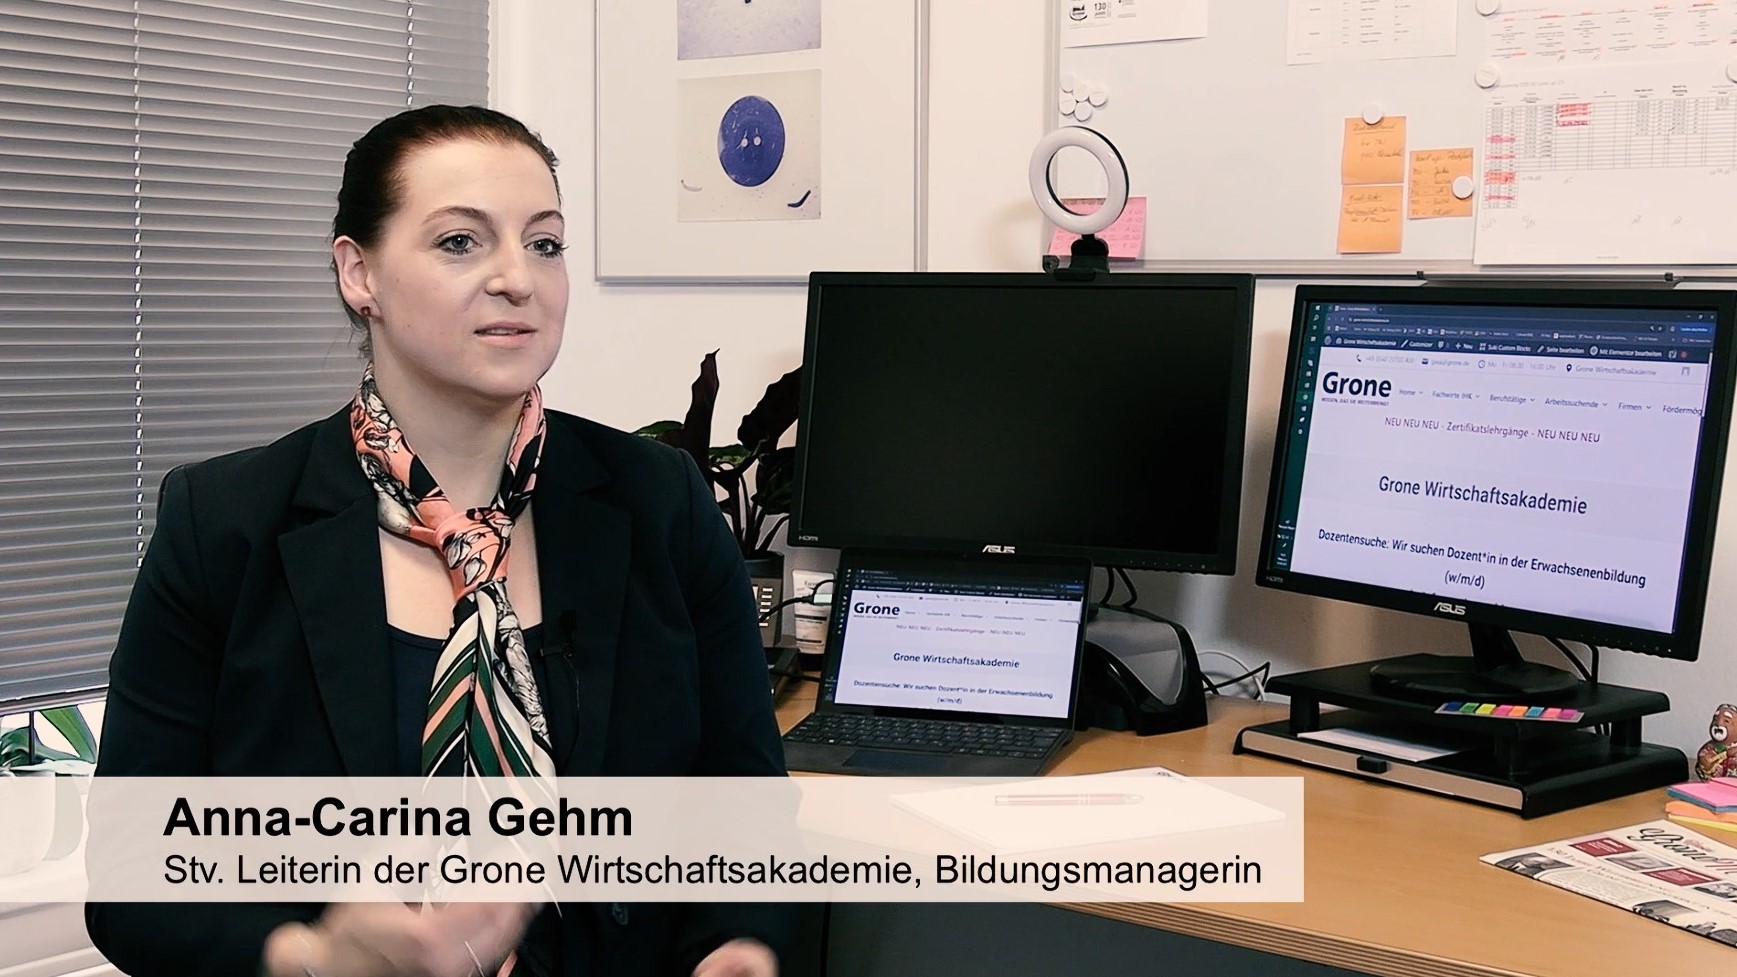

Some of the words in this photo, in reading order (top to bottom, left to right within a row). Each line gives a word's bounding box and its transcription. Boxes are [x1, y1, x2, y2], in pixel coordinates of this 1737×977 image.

[1322, 371, 1392, 397] Grone
[1618, 402, 1643, 411] Firmen
[1384, 417, 1401, 427] NEU
[1403, 418, 1420, 428] NEU
[1422, 420, 1440, 430] NEU
[1446, 421, 1529, 439] Zertifikatslehrgänge
[1537, 429, 1556, 439] NEU
[1558, 431, 1578, 441] NEU
[1580, 432, 1600, 443] NEU
[1379, 475, 1420, 495] Grone
[1425, 480, 1588, 514] Wirtschaftsakademie
[982, 545, 1016, 554] ASUS
[1318, 528, 1390, 549] Dozentensuche:
[1392, 539, 1408, 551] Wir
[1410, 543, 1445, 557] suchen
[1498, 553, 1508, 566] in
[1511, 555, 1528, 568] der
[1531, 558, 1647, 588] Erwachsenenbildung
[1444, 570, 1485, 590] (w/m/d)
[854, 602, 901, 616] Grone
[1434, 602, 1466, 615] ASUS
[893, 652, 921, 663] Grone
[923, 654, 1020, 668] Wirtschaftsakademie
